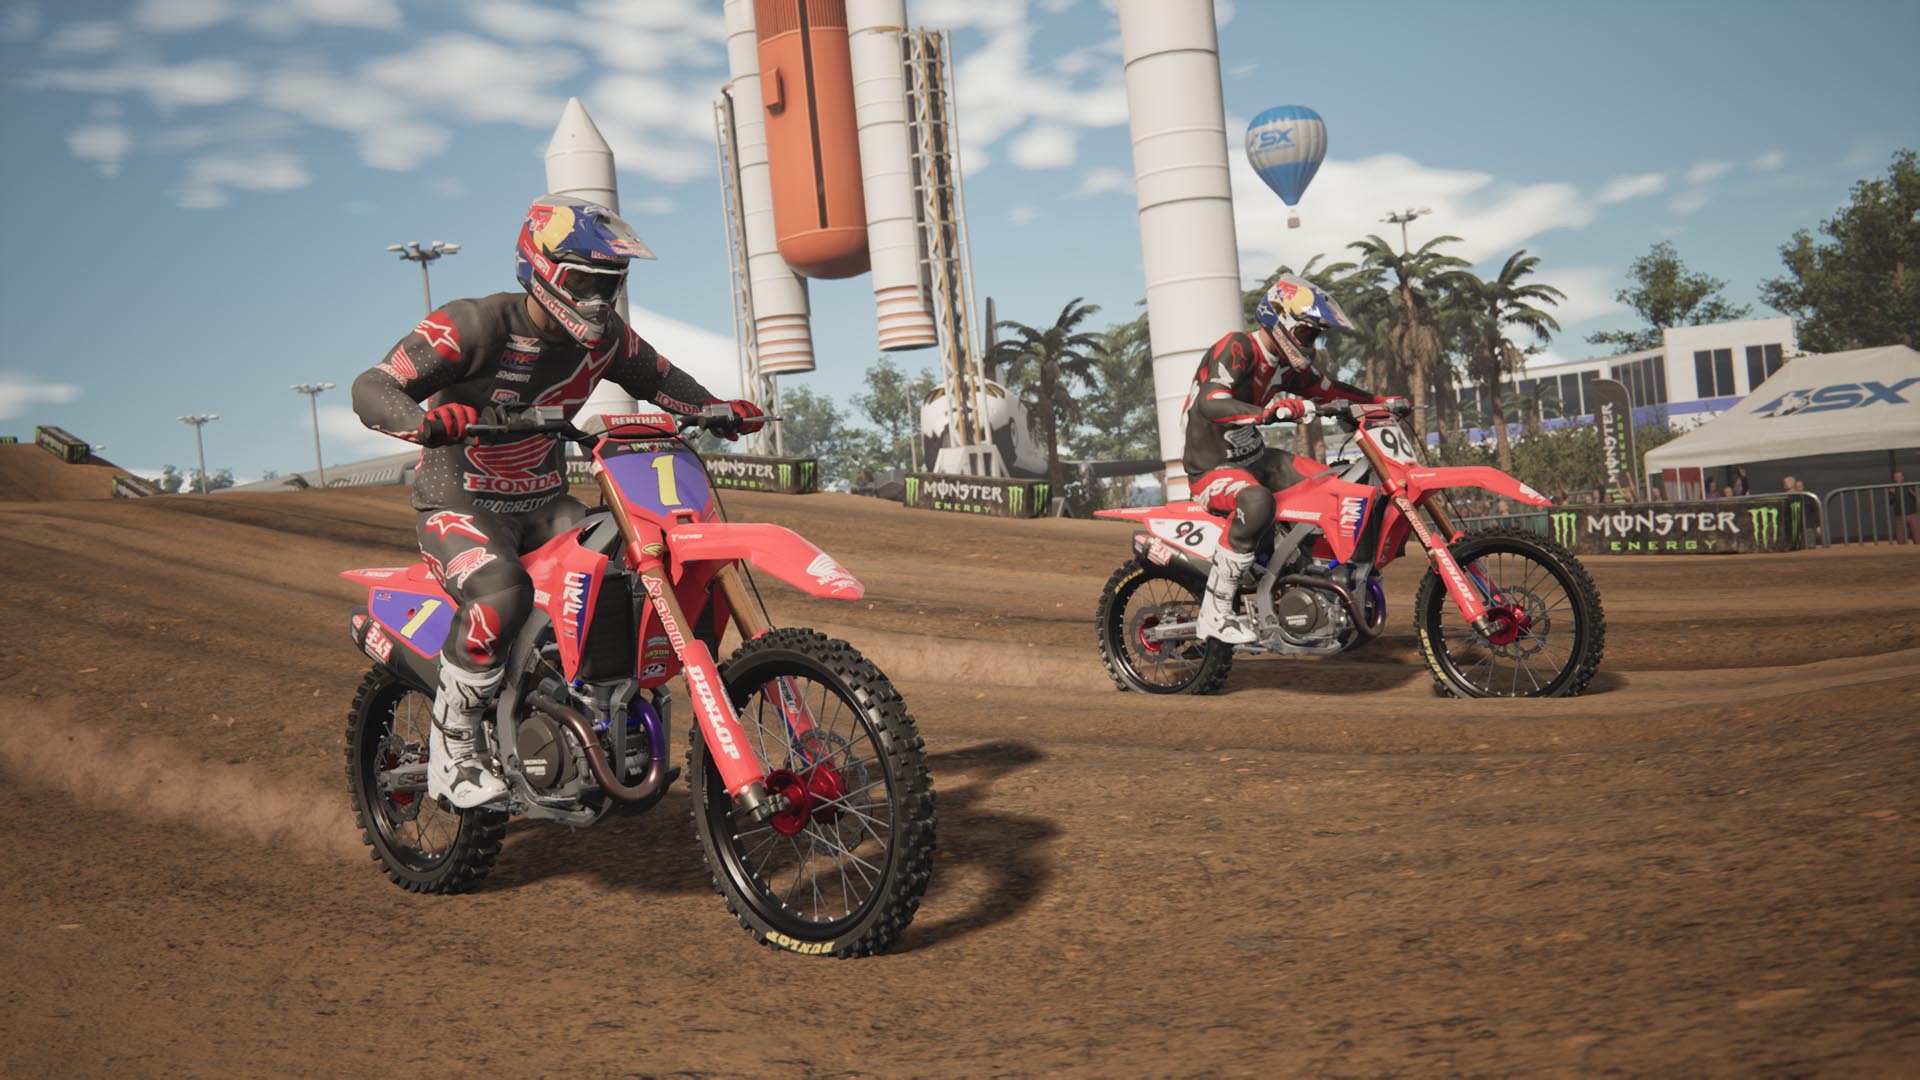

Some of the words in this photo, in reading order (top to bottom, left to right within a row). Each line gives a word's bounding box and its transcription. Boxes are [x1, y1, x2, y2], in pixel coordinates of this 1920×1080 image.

[496, 370, 532, 383] SHOWA
[610, 416, 668, 426] RENTHAL
[1601, 402, 1620, 483] MONSTER
[651, 454, 682, 506] 1
[706, 457, 775, 480] MONSTER
[464, 471, 562, 494] HONDA
[716, 477, 766, 489] ENERGY
[923, 478, 1003, 503] MONSTER
[934, 501, 991, 513] ENERGY
[1173, 521, 1204, 547] 96
[1587, 509, 1741, 538] MONSTER
[1610, 540, 1717, 551] ENERGY
[1436, 548, 1476, 602] DUNLOP
[400, 599, 442, 639] 1
[687, 665, 741, 760] DUNLOP
[765, 930, 835, 955] DUNLOP
